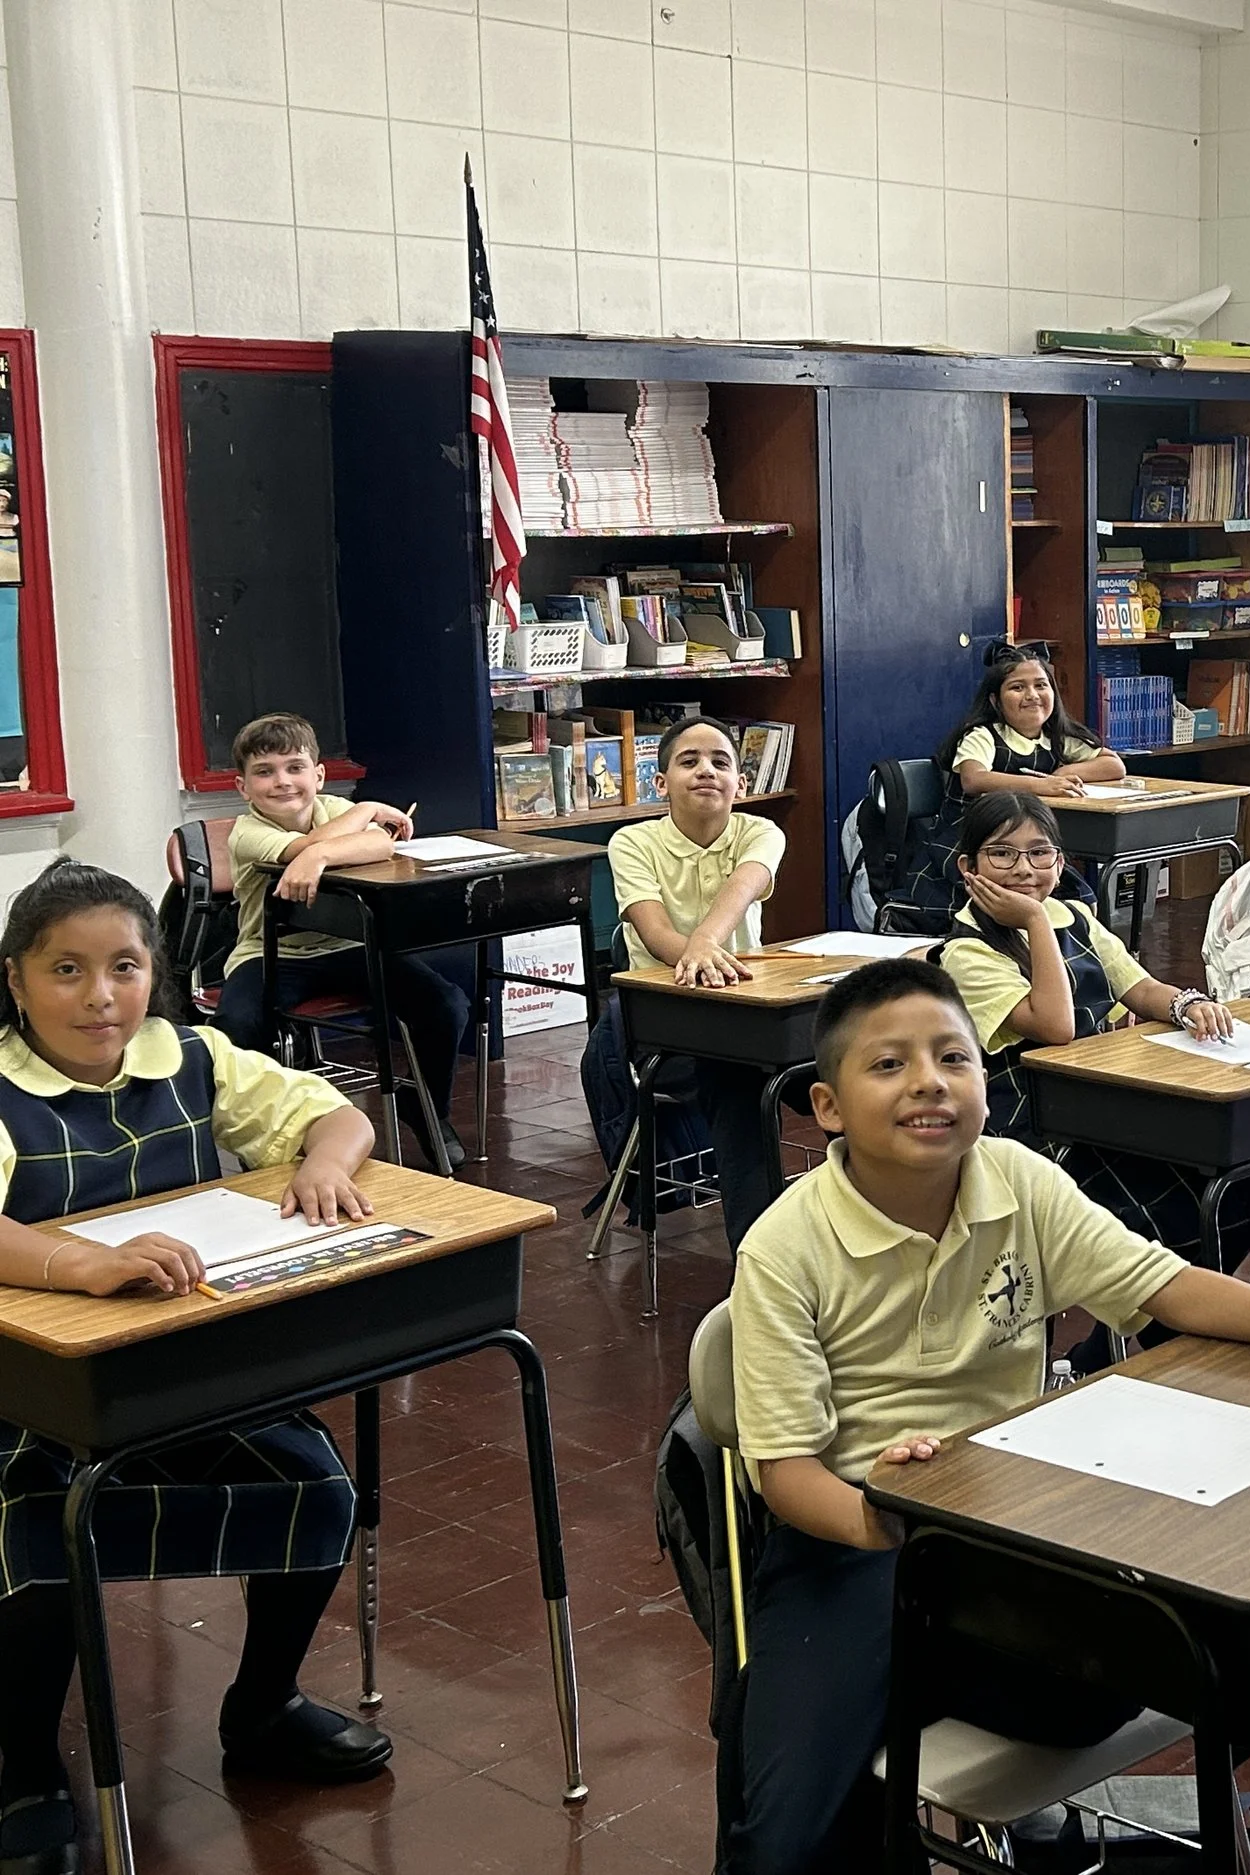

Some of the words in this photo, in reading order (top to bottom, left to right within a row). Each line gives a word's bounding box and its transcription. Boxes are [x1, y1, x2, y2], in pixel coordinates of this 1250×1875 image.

[1120, 607, 1129, 625] 0
[1133, 607, 1140, 625] 0
[551, 962, 575, 977] Joy
[507, 986, 562, 1001] Read
[981, 1268, 996, 1285] ST.
[977, 1292, 989, 1311] ST.
[1019, 1263, 1035, 1313] CABRINI
